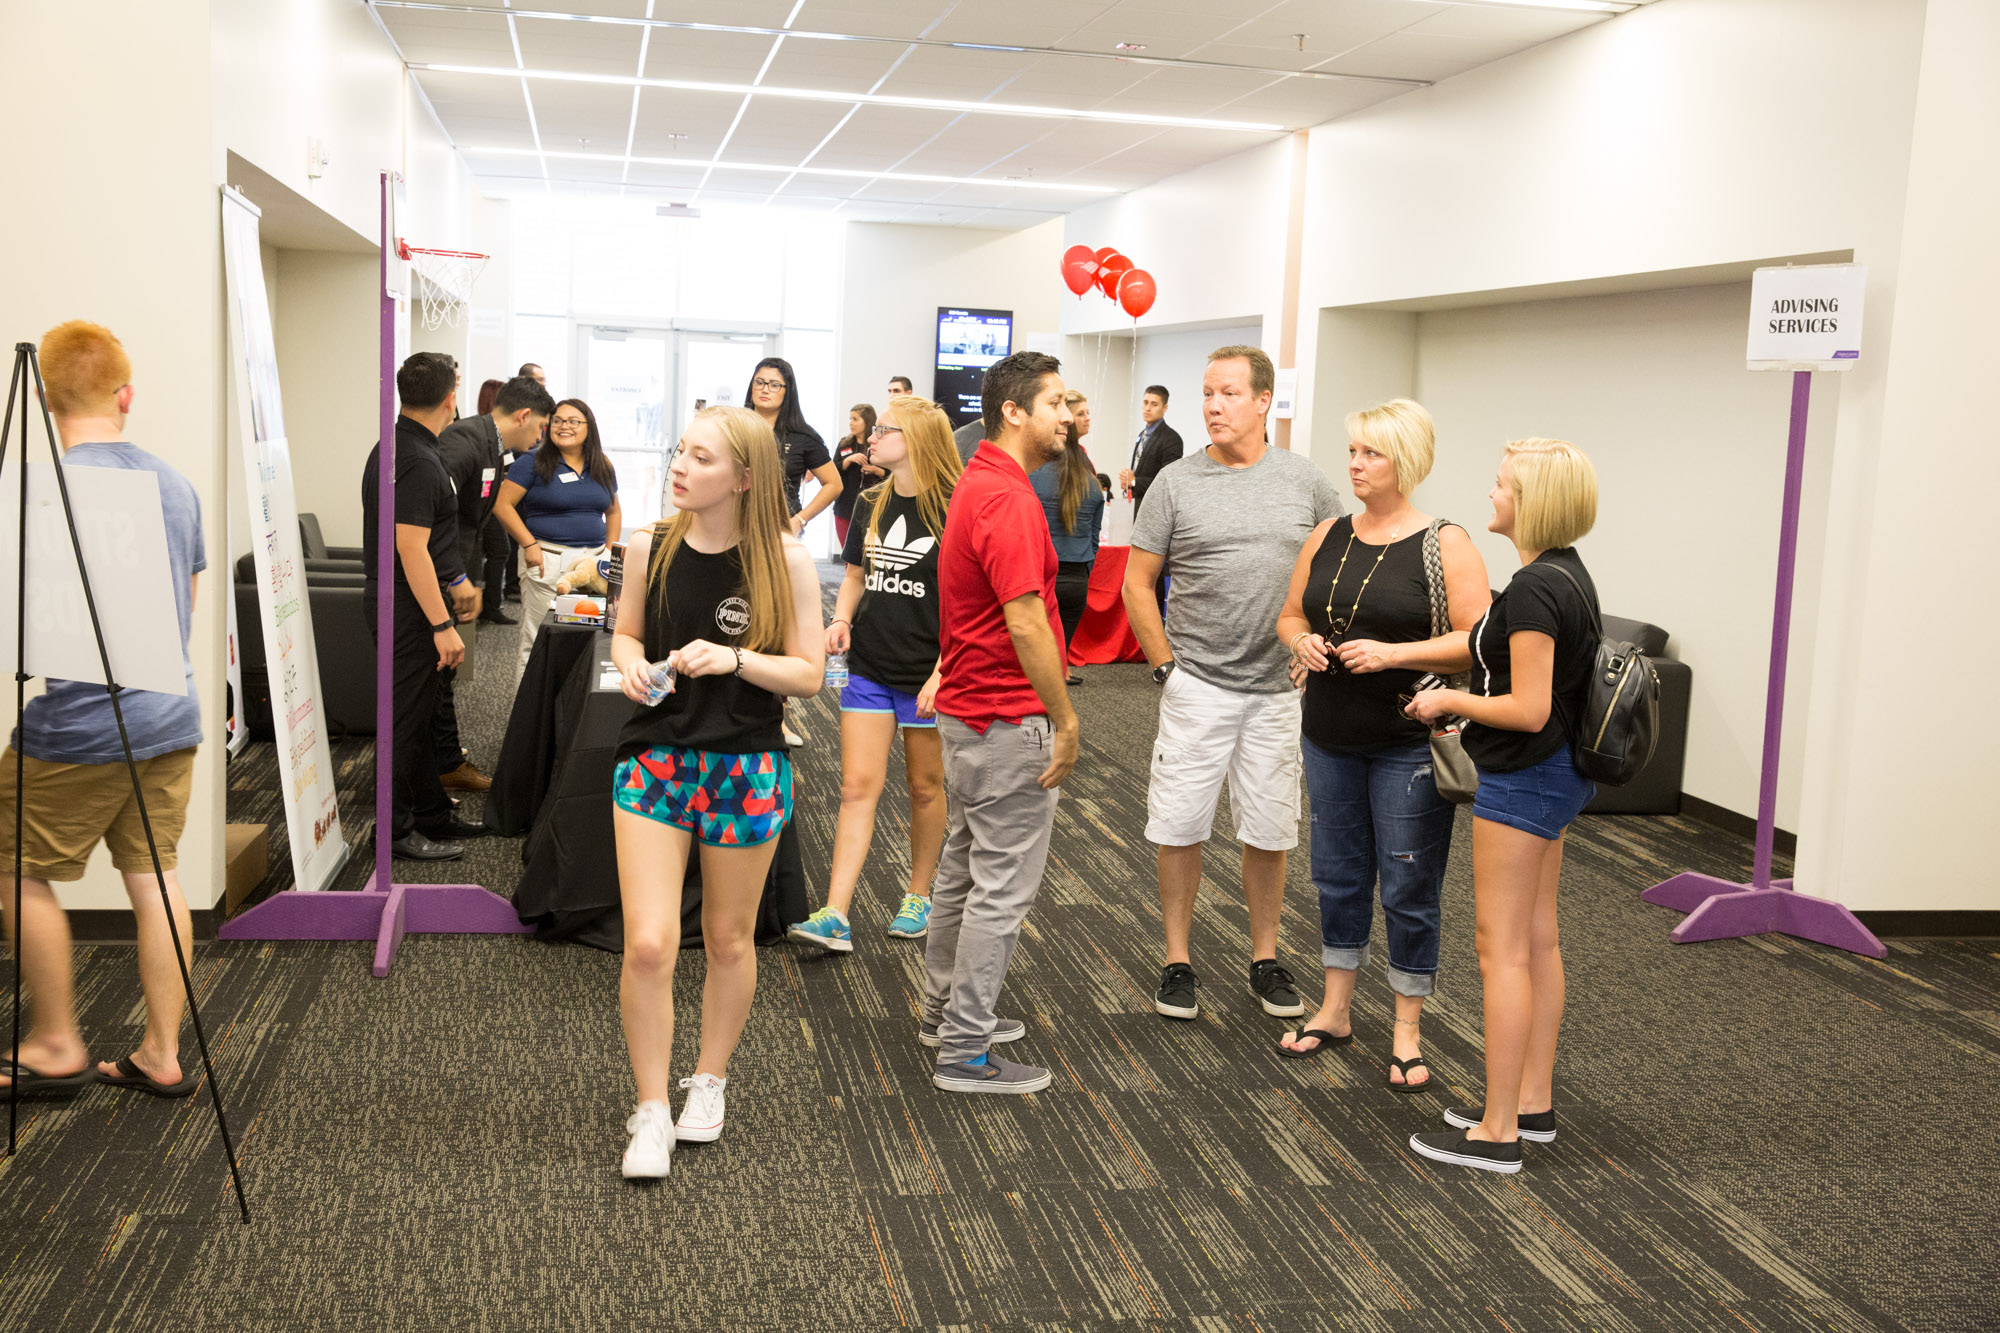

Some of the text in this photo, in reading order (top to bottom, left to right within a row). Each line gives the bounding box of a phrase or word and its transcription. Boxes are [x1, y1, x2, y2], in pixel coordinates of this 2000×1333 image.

[1770, 297, 1838, 314] ADVISING
[1768, 318, 1838, 334] SERVICES
[864, 570, 926, 598] didas
[718, 607, 750, 624] PINK
